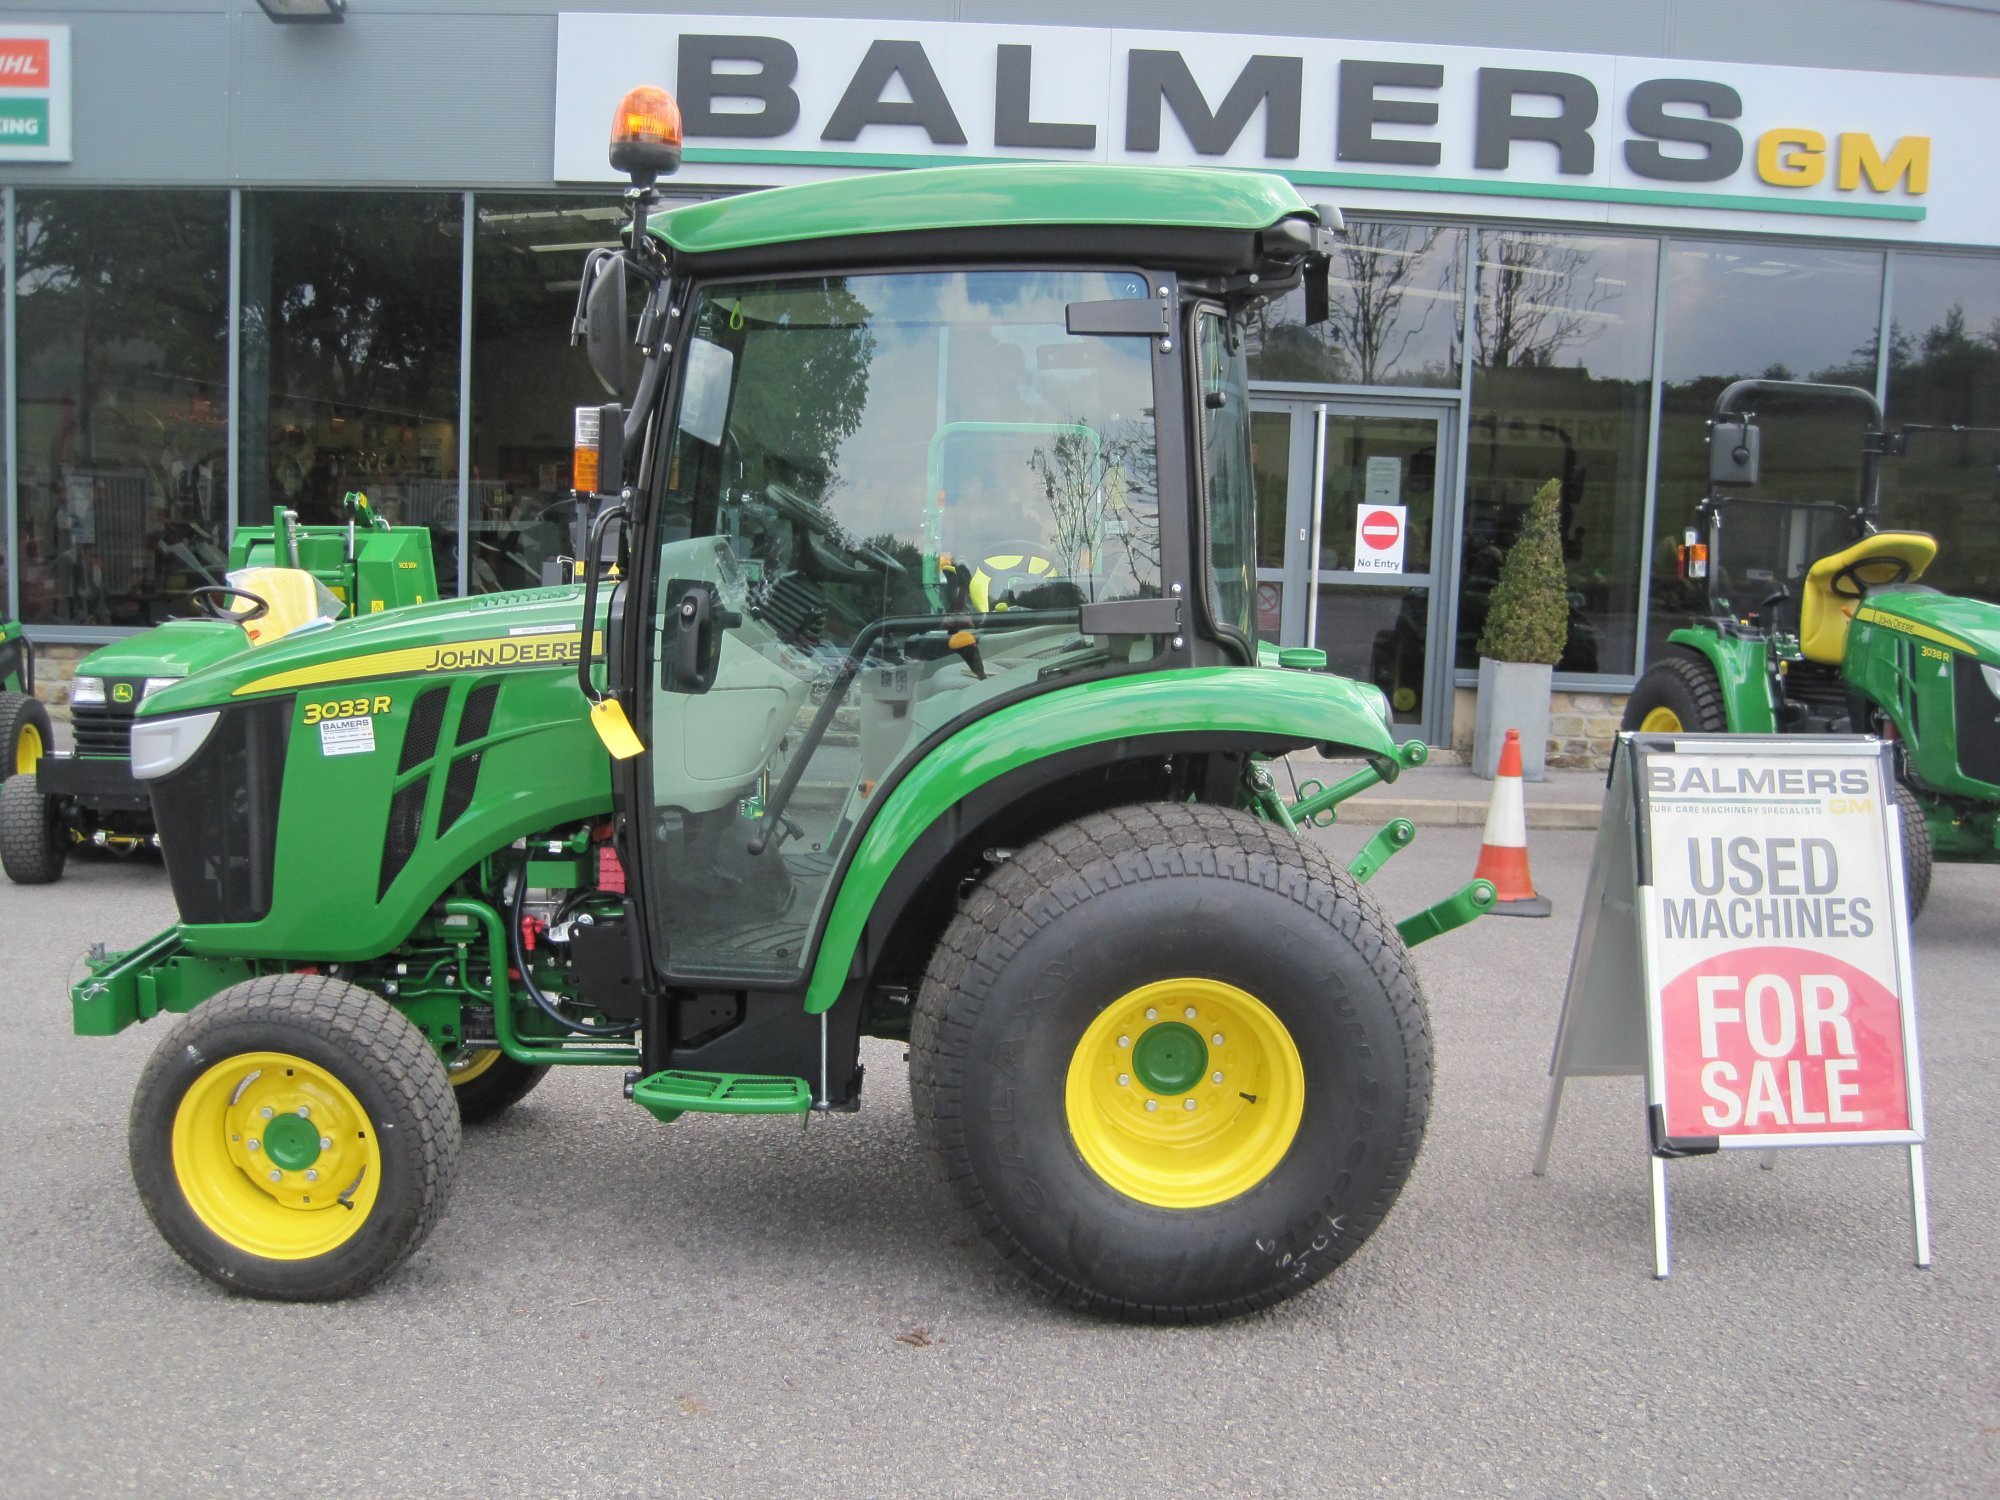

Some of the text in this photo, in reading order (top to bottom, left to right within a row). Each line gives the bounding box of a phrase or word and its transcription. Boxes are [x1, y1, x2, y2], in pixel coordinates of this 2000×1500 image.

[0, 118, 39, 135] ING
[676, 32, 1931, 196] BALMERS GM
[1357, 558, 1400, 571] No Entry
[1894, 618, 1915, 634] DEERE
[426, 640, 582, 670] JOHN DEERE
[303, 695, 391, 725] 3033 R
[322, 719, 369, 731] BALMERS
[1648, 766, 1869, 794] BALMERS
[1650, 799, 1873, 815] TURF CARE MACHINERY SPECIALISTS GM
[1687, 836, 1839, 896] USED
[1662, 897, 1874, 939] MACHINES
[1697, 973, 1857, 1058] FOR
[1701, 1058, 1864, 1128] SALE
